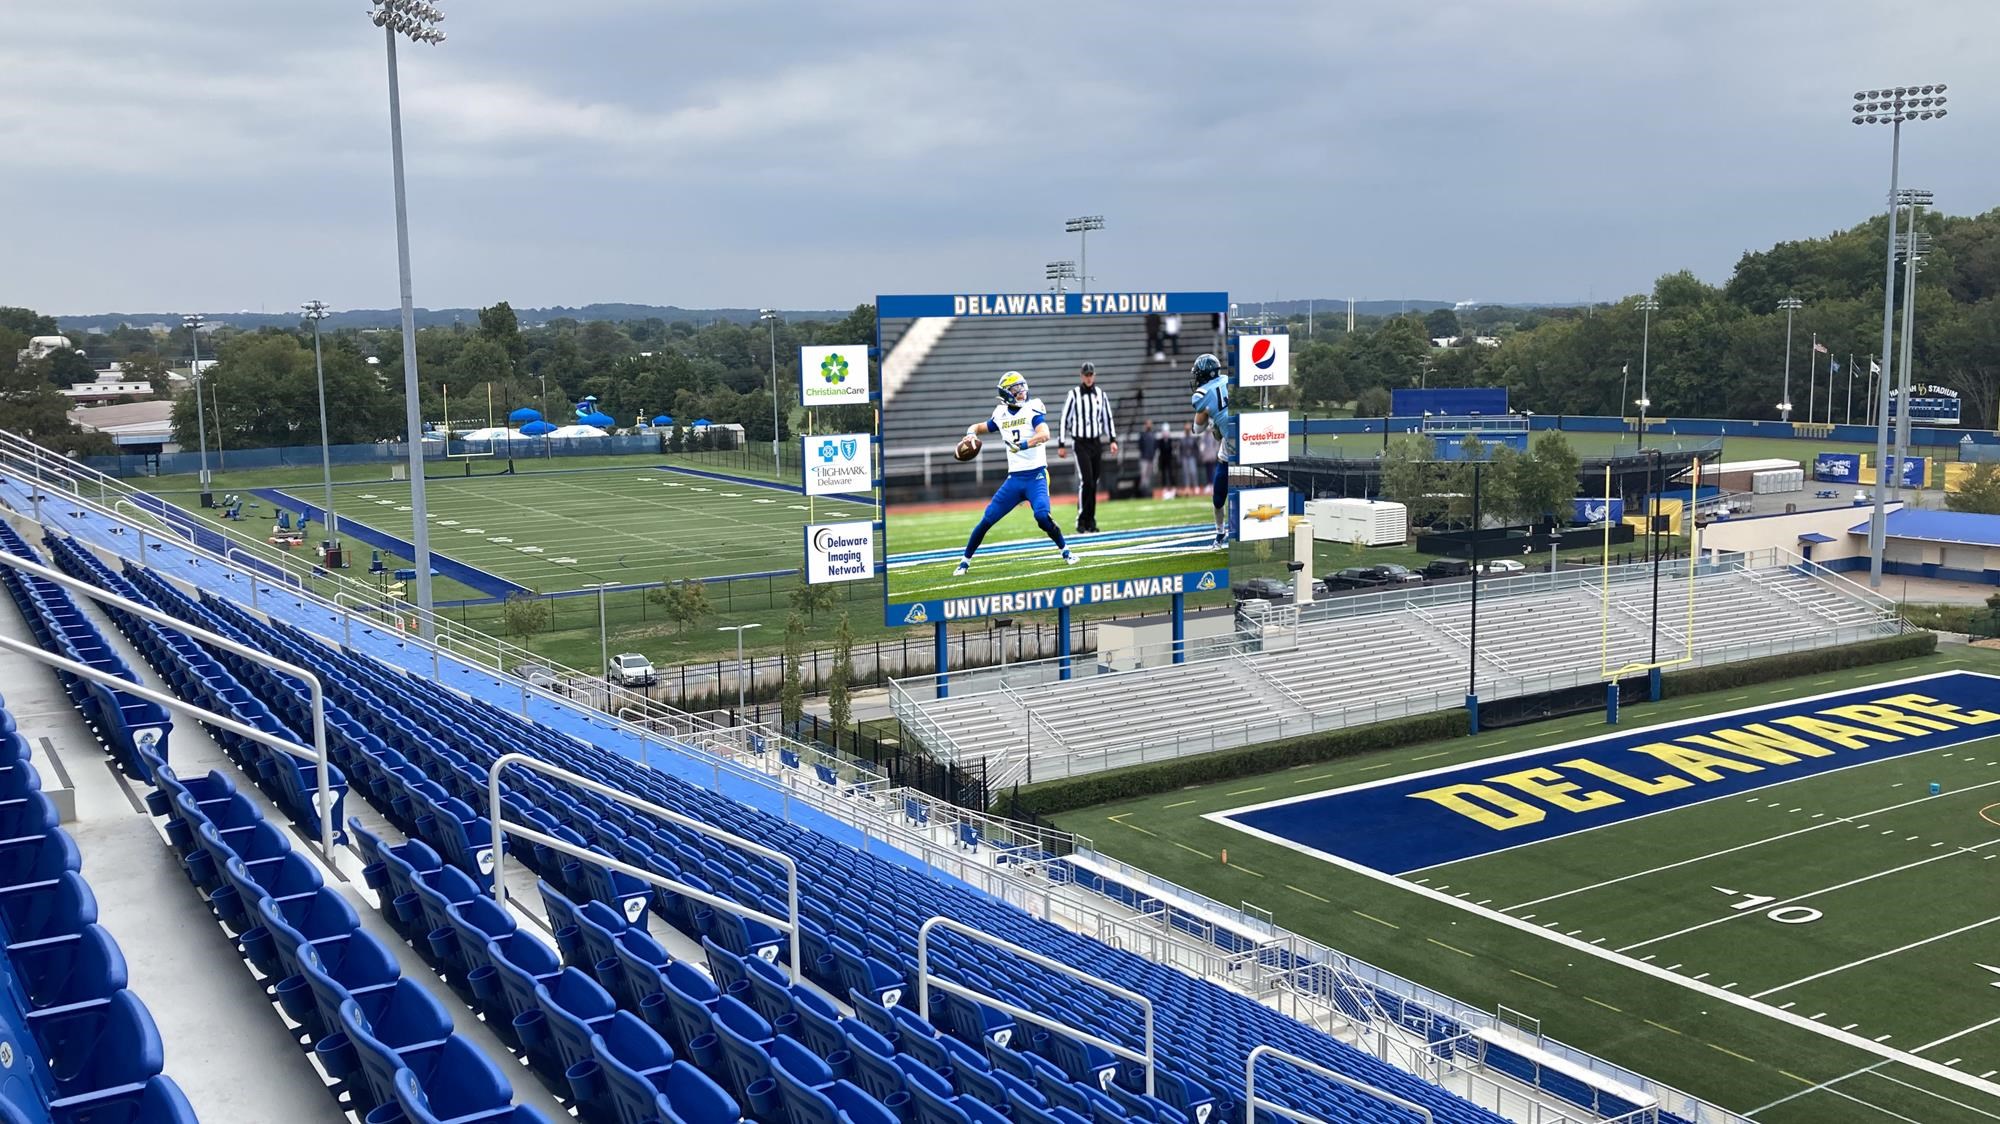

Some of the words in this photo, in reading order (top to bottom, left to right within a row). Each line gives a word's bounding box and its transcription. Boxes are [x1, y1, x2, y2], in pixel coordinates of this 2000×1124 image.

[954, 295, 1066, 315] DELAWARE
[1081, 294, 1167, 313] STADIUM
[1253, 372, 1274, 383] pepsi
[806, 387, 865, 397] ChristianaCare
[1928, 384, 1958, 398] STADIUM
[1002, 418, 1025, 429] DELAWARE
[1242, 433, 1266, 441] Grotto
[1266, 431, 1286, 440] Pizza
[817, 478, 852, 487] Delaware
[827, 535, 868, 549] Delaware
[828, 549, 861, 564] Imaging
[828, 562, 866, 577] Network
[943, 589, 1057, 620] UNIVERSITY
[1062, 585, 1085, 605] OF
[1091, 575, 1184, 603] DELAWARE
[1406, 693, 2000, 831] DELAWARE
[1730, 893, 1824, 924] 10
